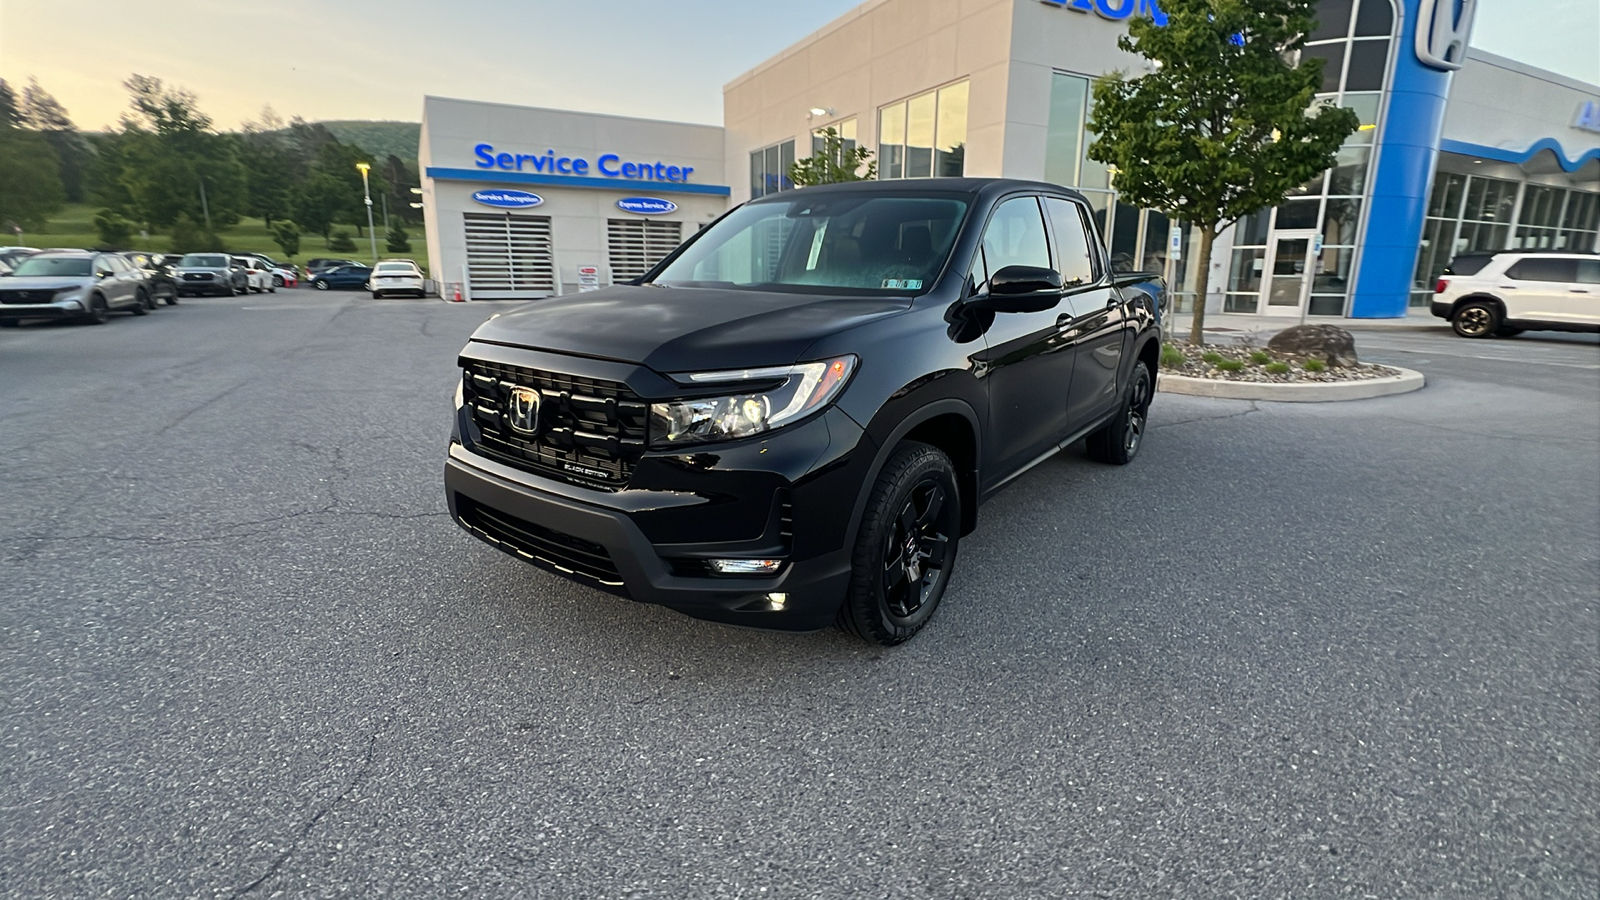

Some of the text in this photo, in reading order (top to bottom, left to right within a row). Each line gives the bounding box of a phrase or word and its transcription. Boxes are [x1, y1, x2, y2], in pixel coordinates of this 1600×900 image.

[475, 144, 693, 182] Service Center
[475, 192, 503, 202] Service
